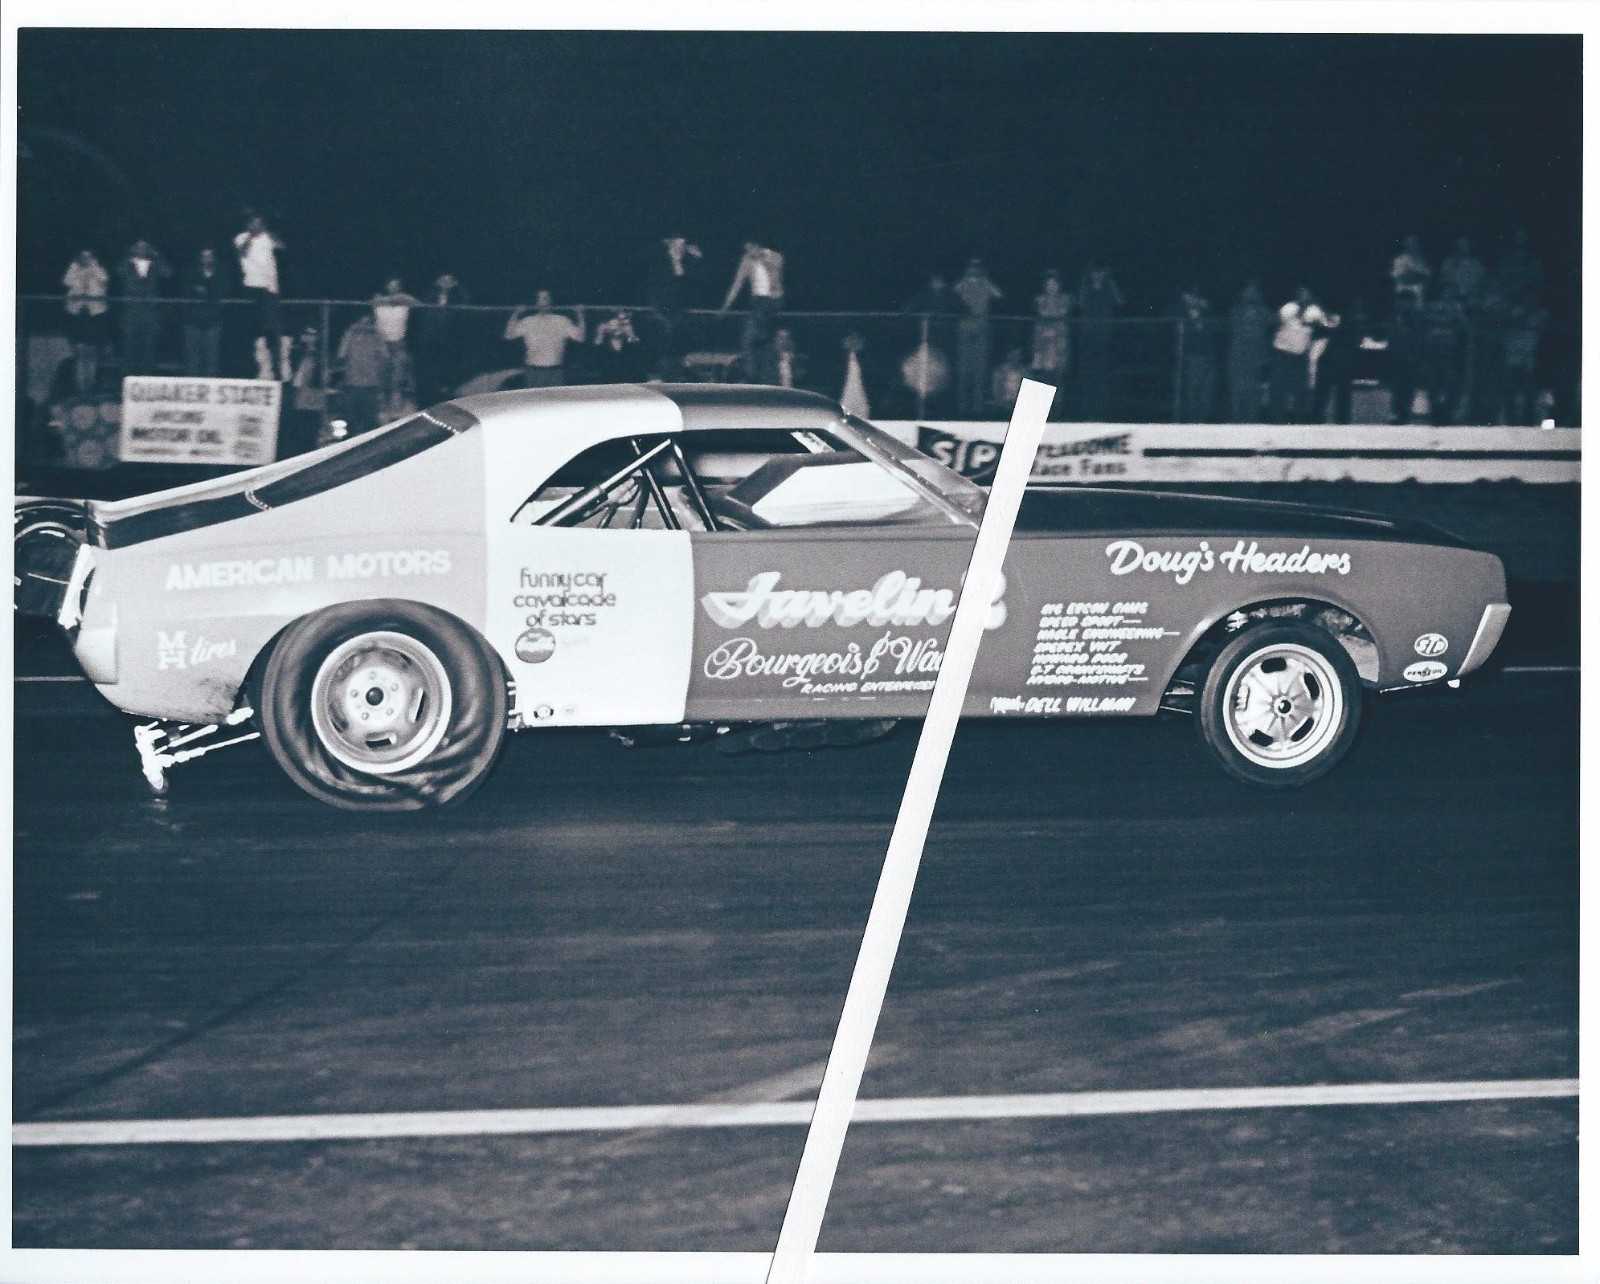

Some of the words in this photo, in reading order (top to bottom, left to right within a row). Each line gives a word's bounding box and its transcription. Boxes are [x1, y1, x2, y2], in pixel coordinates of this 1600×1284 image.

[131, 382, 211, 403] QUAKER
[217, 384, 274, 407] STATE
[131, 426, 191, 443] MOTOR
[196, 429, 223, 445] OIL
[1080, 458, 1126, 476] Fans
[166, 556, 313, 590] AMERICAN
[327, 550, 452, 580] MOTORS
[1105, 540, 1215, 585] Doug's
[1219, 540, 1351, 575] Headers
[520, 567, 571, 593] funny
[573, 572, 607, 588] car
[512, 589, 617, 608] cavalcade
[702, 570, 957, 629] Javelin
[525, 609, 546, 627] of
[548, 611, 597, 626] stars
[1415, 636, 1446, 654] STP
[703, 637, 864, 688] Bourgeois
[800, 683, 859, 694] RACING
